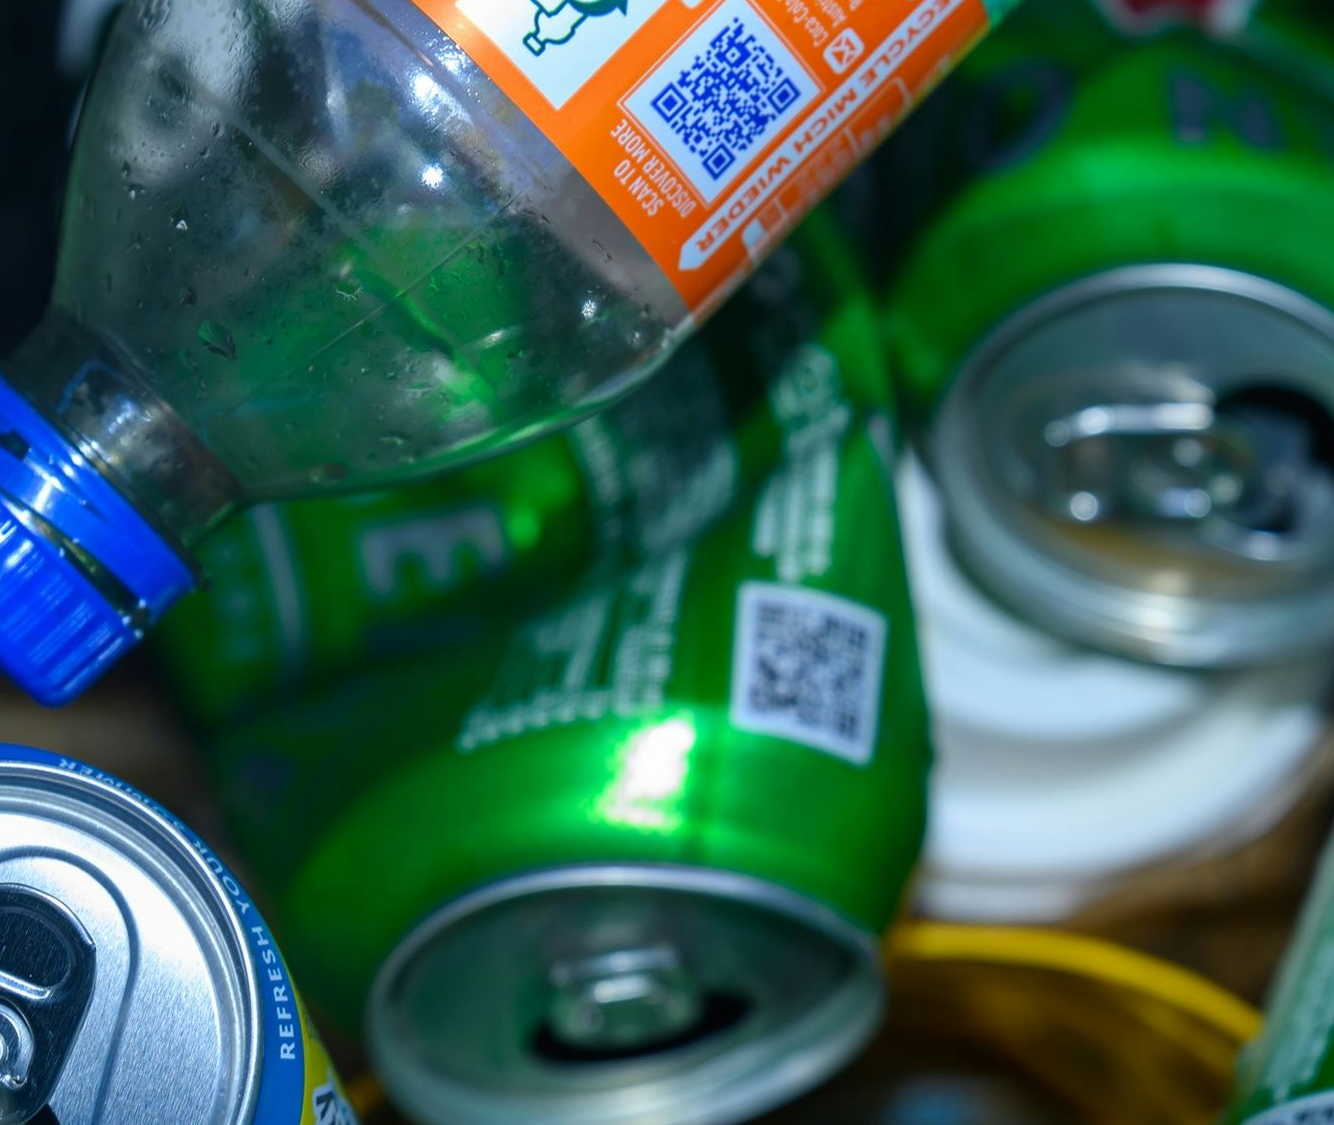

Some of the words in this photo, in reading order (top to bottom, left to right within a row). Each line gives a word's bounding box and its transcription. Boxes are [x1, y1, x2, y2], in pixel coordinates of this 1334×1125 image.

[611, 118, 651, 162] MORE
[793, 88, 858, 154] MICH
[613, 159, 637, 186] TO
[628, 177, 664, 217] SCAN
[643, 153, 697, 218] DISCOVER
[695, 155, 791, 252] WIEDER
[193, 839, 250, 914] YOUR
[252, 926, 296, 1060] REFRESH
